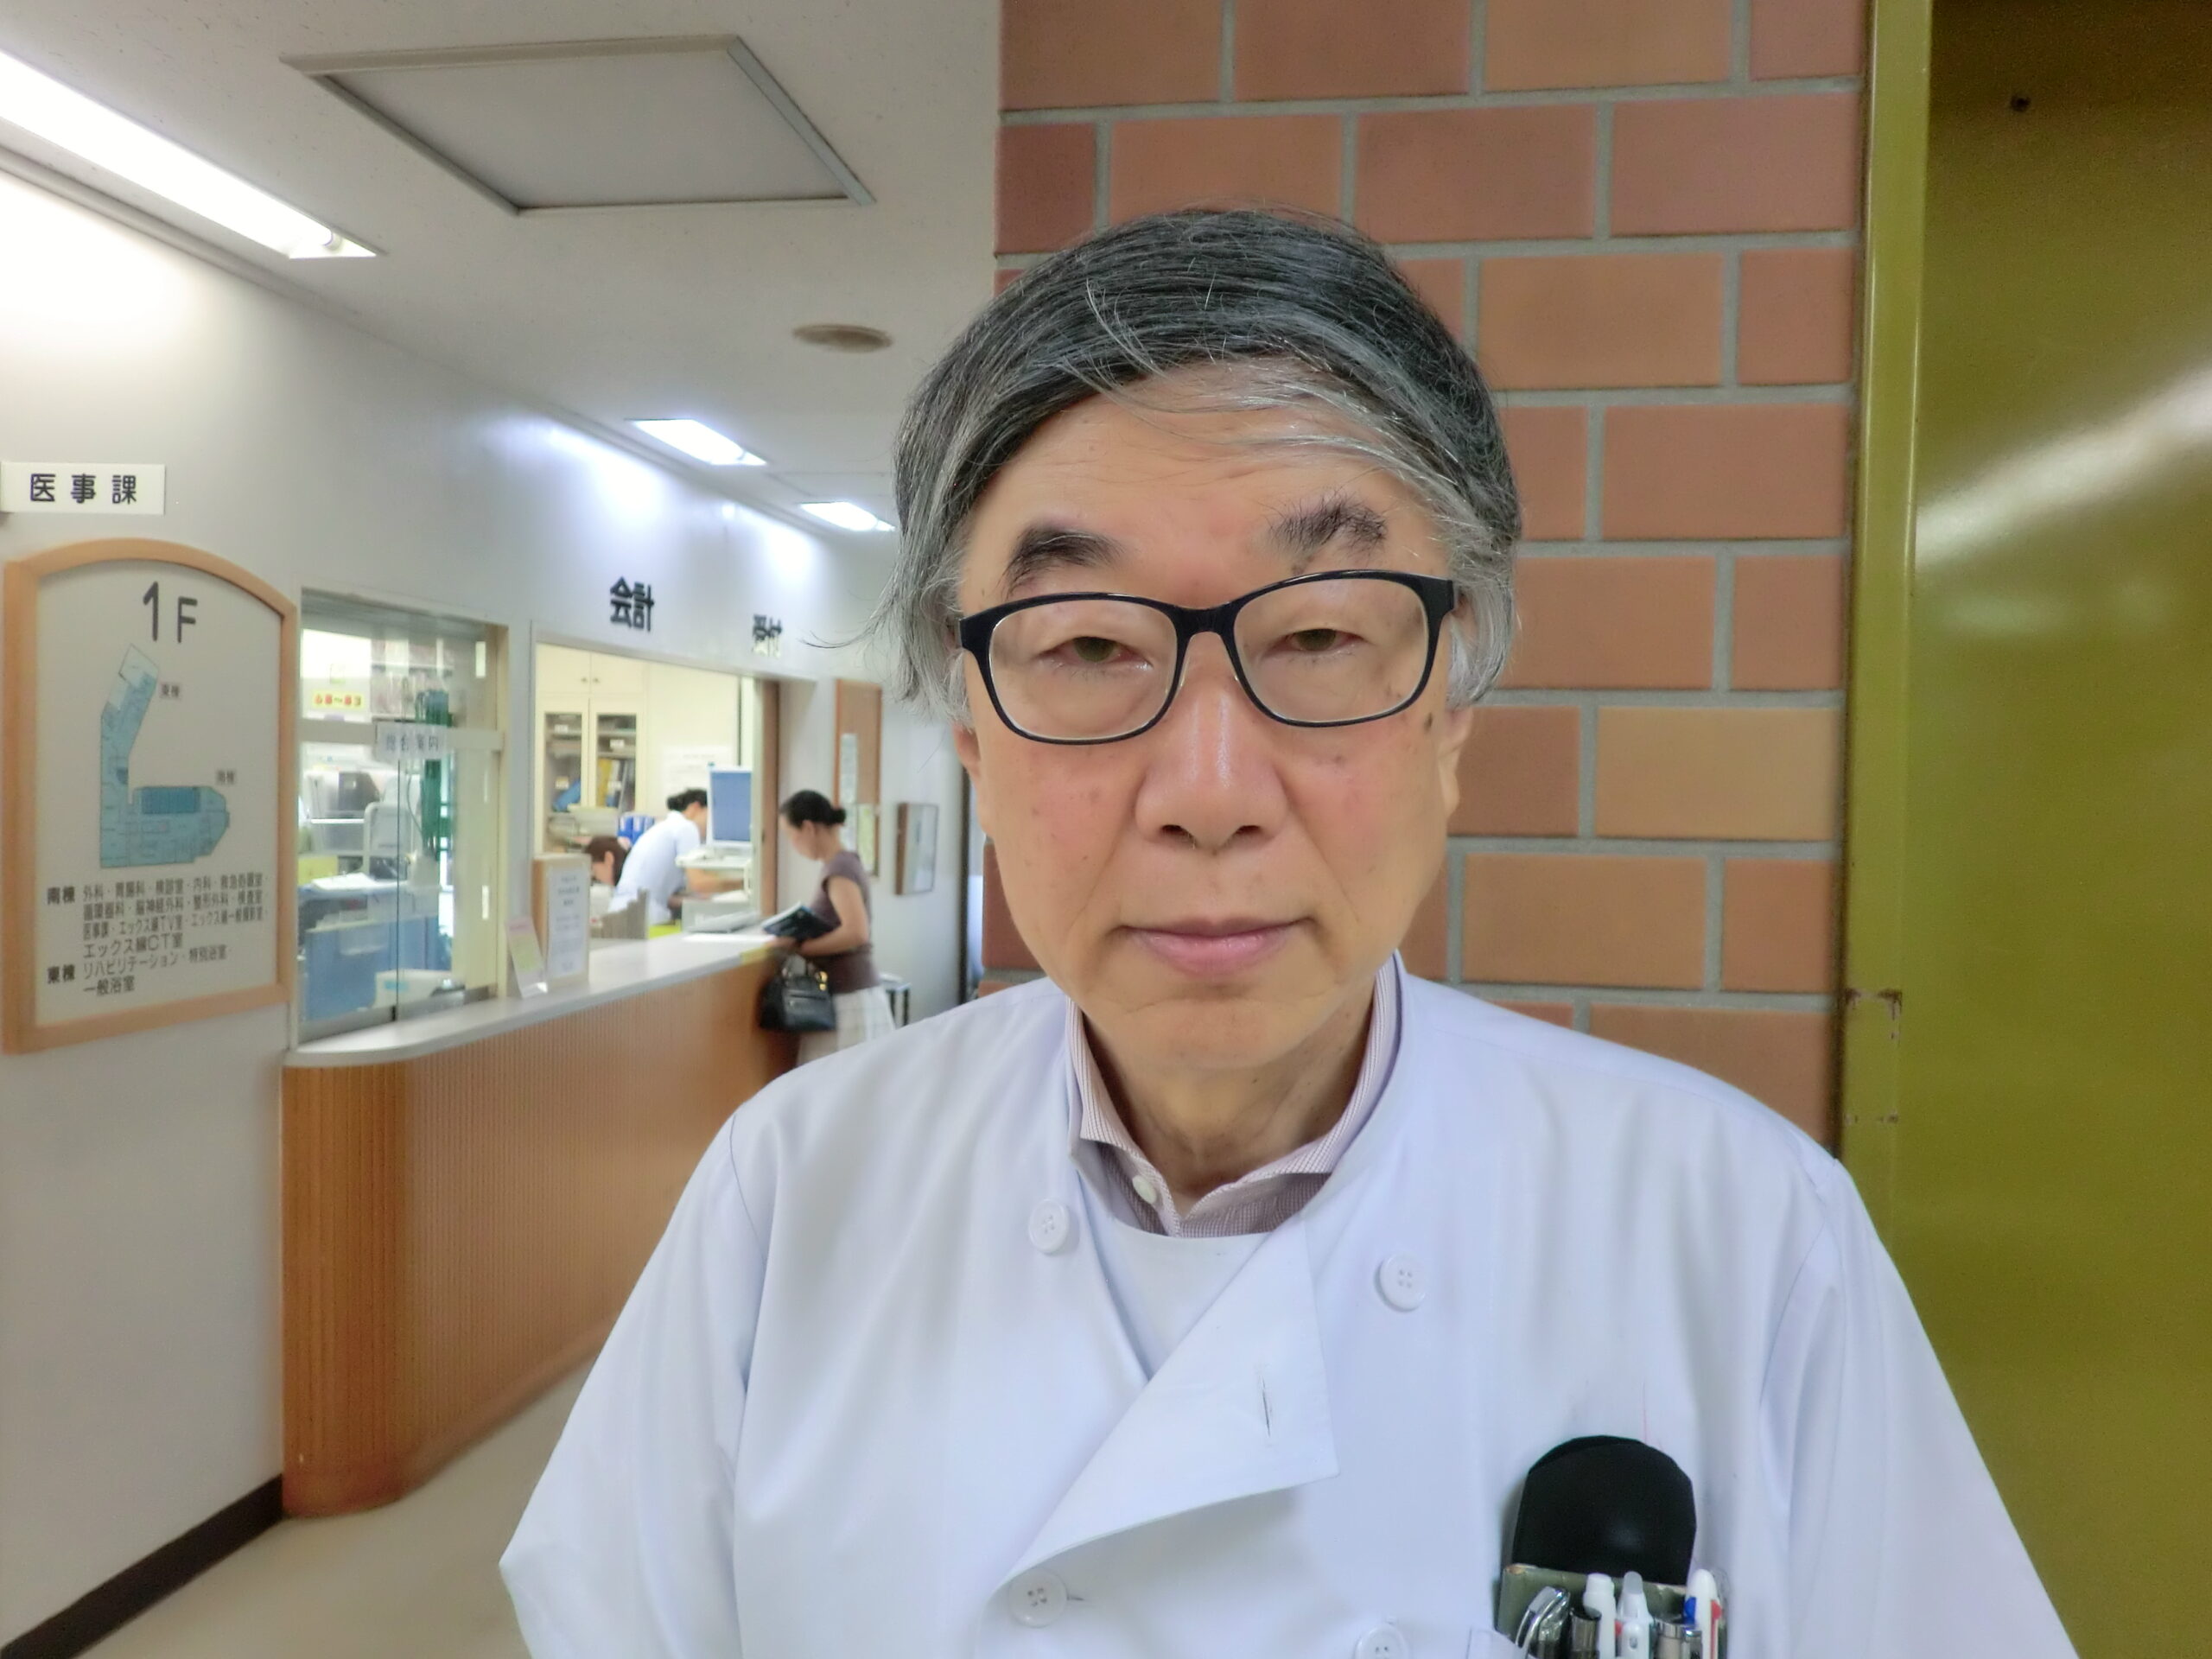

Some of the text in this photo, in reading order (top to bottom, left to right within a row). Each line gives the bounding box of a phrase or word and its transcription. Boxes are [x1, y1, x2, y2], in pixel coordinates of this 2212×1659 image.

[30, 473, 137, 505] 医事課
[143, 581, 198, 643] 1F
[610, 576, 654, 632] 会計
